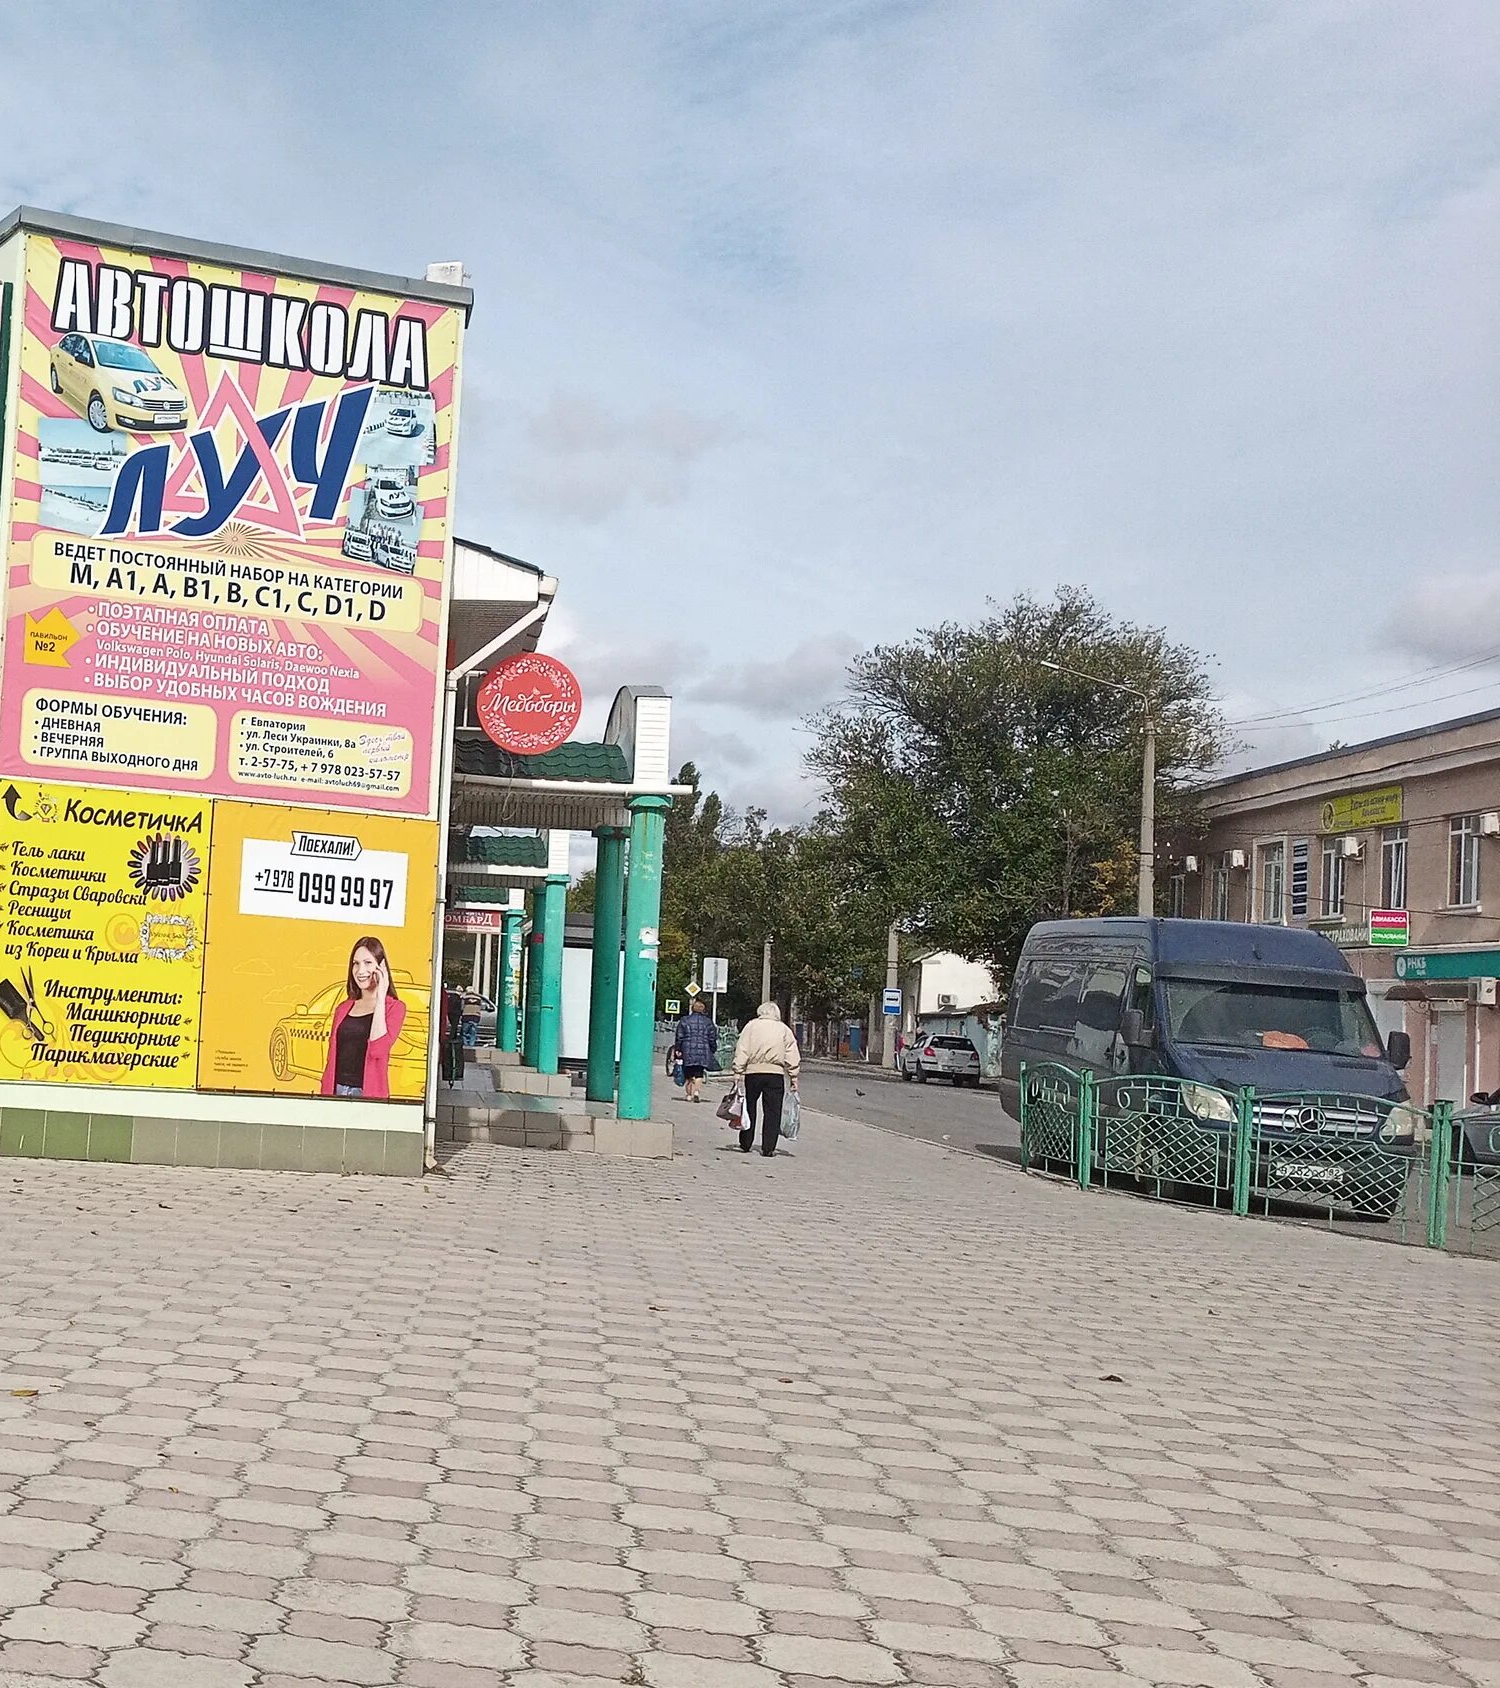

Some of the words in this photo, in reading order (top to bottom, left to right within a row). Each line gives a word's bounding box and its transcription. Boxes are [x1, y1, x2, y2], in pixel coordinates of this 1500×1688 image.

[51, 256, 428, 391] АВТОШКОЛА
[98, 386, 377, 538] ЛУЧ
[54, 541, 106, 563] ВЕДЕТ
[109, 548, 226, 577] ПОСТОЯННЫЙ
[230, 564, 284, 584] НАБОР
[288, 571, 310, 587] НА
[313, 575, 404, 600] КАТЕГОРИИ
[97, 601, 200, 627] ПОЭТАПНАЯ
[202, 613, 269, 636] ОПЛАТА
[325, 594, 363, 622] D1,
[369, 600, 386, 621] D
[30, 631, 68, 642] ПАВИЛЬОН
[34, 640, 56, 652] №2
[96, 620, 186, 646] ОБУЧЕНИЕ
[187, 633, 211, 649] НА
[213, 633, 274, 655] НОВЫХ
[276, 642, 324, 662] АВТО:
[96, 639, 164, 658] Volkswagen
[166, 647, 193, 661] Polo,
[195, 651, 242, 668] Hyundai
[243, 653, 283, 671] Solaris,
[284, 659, 328, 676] Daewoo
[329, 665, 360, 679] Nexia
[94, 653, 259, 686] ИНДИВИДУАЛЬНЫЙ
[261, 671, 330, 695] ПОДХОД
[93, 672, 153, 692] ВЫБОР
[156, 679, 238, 702] УДОБНЫХ
[241, 688, 295, 708] ЧАСОВ
[298, 694, 387, 718] ВОЖДЕНИЯ
[480, 692, 579, 718] Медоборы
[35, 697, 97, 717] ФОРМЫ
[101, 704, 188, 726] ОБУЧЕНИЯ:
[250, 717, 306, 732] Евпатория
[41, 717, 101, 733] ДНЕВНАЯ
[40, 732, 105, 748] ВЕЧЕРНЯЯ
[245, 742, 260, 752] ул.
[262, 743, 326, 759] Строителей,
[327, 749, 335, 759] 6
[246, 730, 261, 741] ул.
[262, 731, 288, 743] Леси
[290, 734, 343, 749] Украинки,
[344, 739, 357, 749] 8а
[40, 746, 88, 761] ГРУППА
[91, 751, 171, 768] ВЫХОДНОГО
[172, 759, 198, 772] ДНЯ
[239, 756, 248, 767] т.
[251, 757, 298, 773] 2-57-75,
[320, 763, 342, 775] 978
[344, 765, 401, 782] 023-57-57
[11, 840, 45, 858] Гель
[47, 848, 86, 862] лаки
[10, 861, 107, 883] Косметички
[8, 880, 70, 903] Стразы
[72, 885, 148, 908] Сваровски
[254, 868, 271, 887] +7
[273, 870, 294, 889] 978
[298, 872, 337, 905] 099
[340, 876, 365, 907] 99
[369, 878, 394, 910] 97
[7, 900, 72, 922] Ресницы
[445, 912, 493, 926] ОМБАРД
[6, 919, 95, 941] Косметика
[4, 943, 23, 960] из
[26, 941, 70, 962] Кореи
[72, 948, 82, 959] и
[85, 945, 139, 966] Крыма
[43, 978, 184, 1007] Инструменты:
[66, 1002, 183, 1029] Маникюрные
[69, 1024, 182, 1050] Педикюрные
[31, 1043, 181, 1071] Парикмахерские
